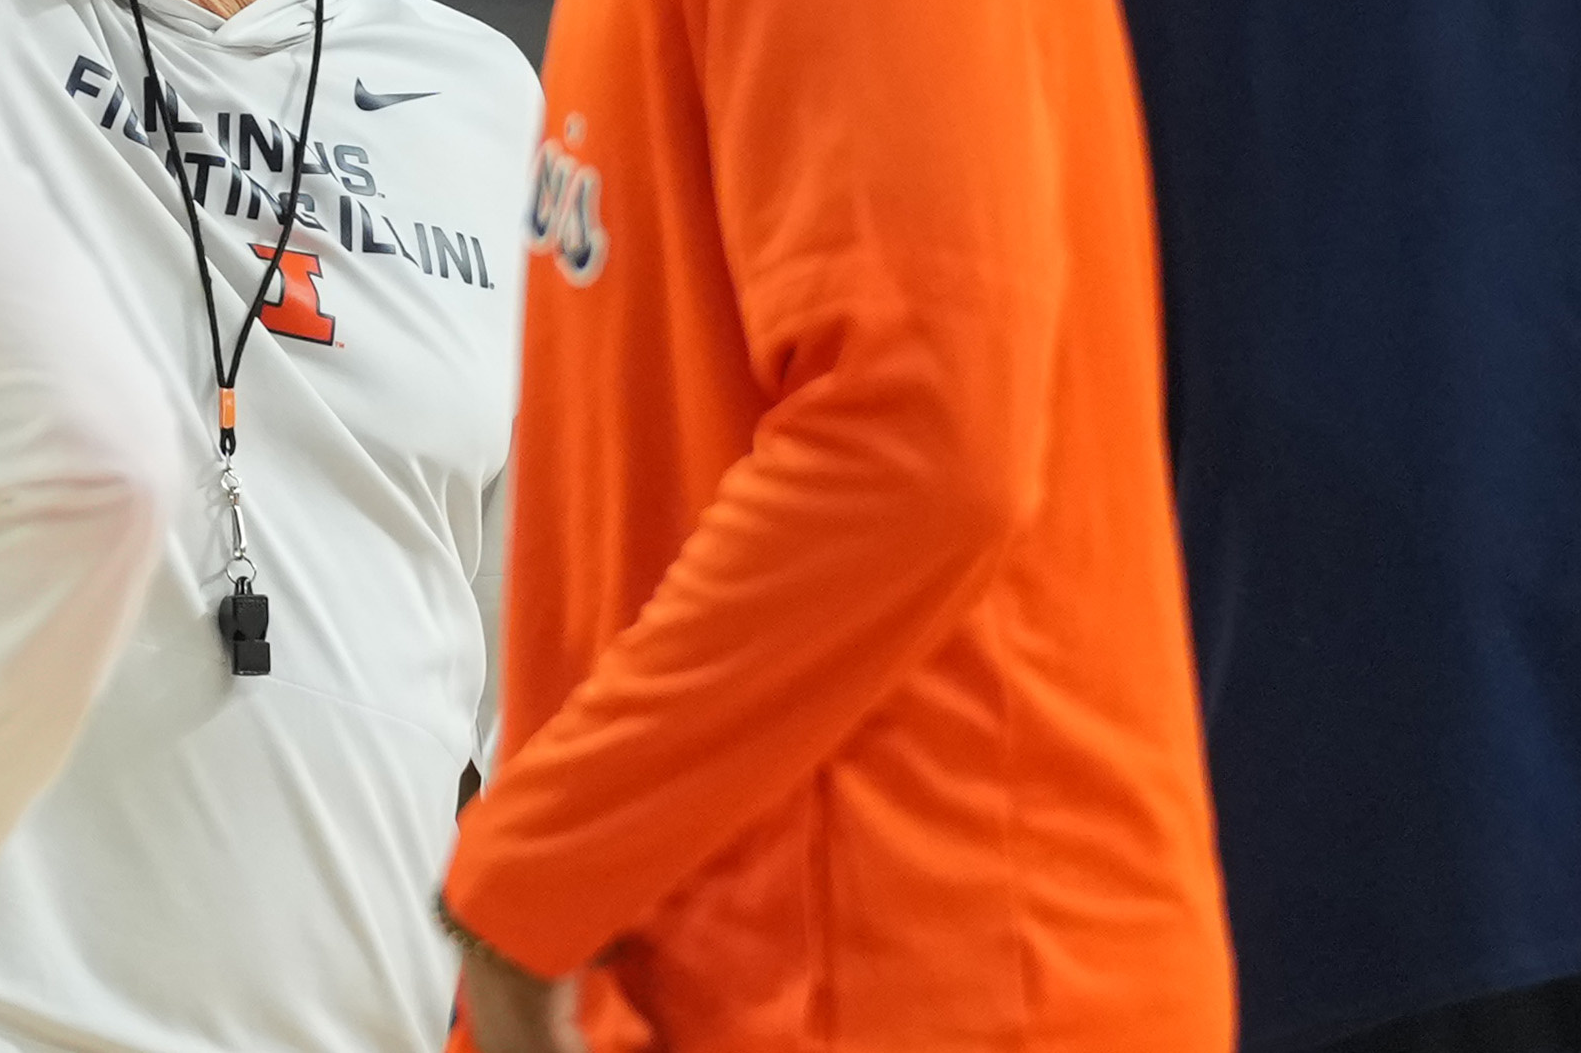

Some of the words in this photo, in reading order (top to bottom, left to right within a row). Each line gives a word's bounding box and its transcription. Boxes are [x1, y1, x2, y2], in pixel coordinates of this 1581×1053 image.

[65, 54, 328, 233] FITING
[339, 195, 489, 289] ILINI
[143, 76, 376, 196] ILINS
